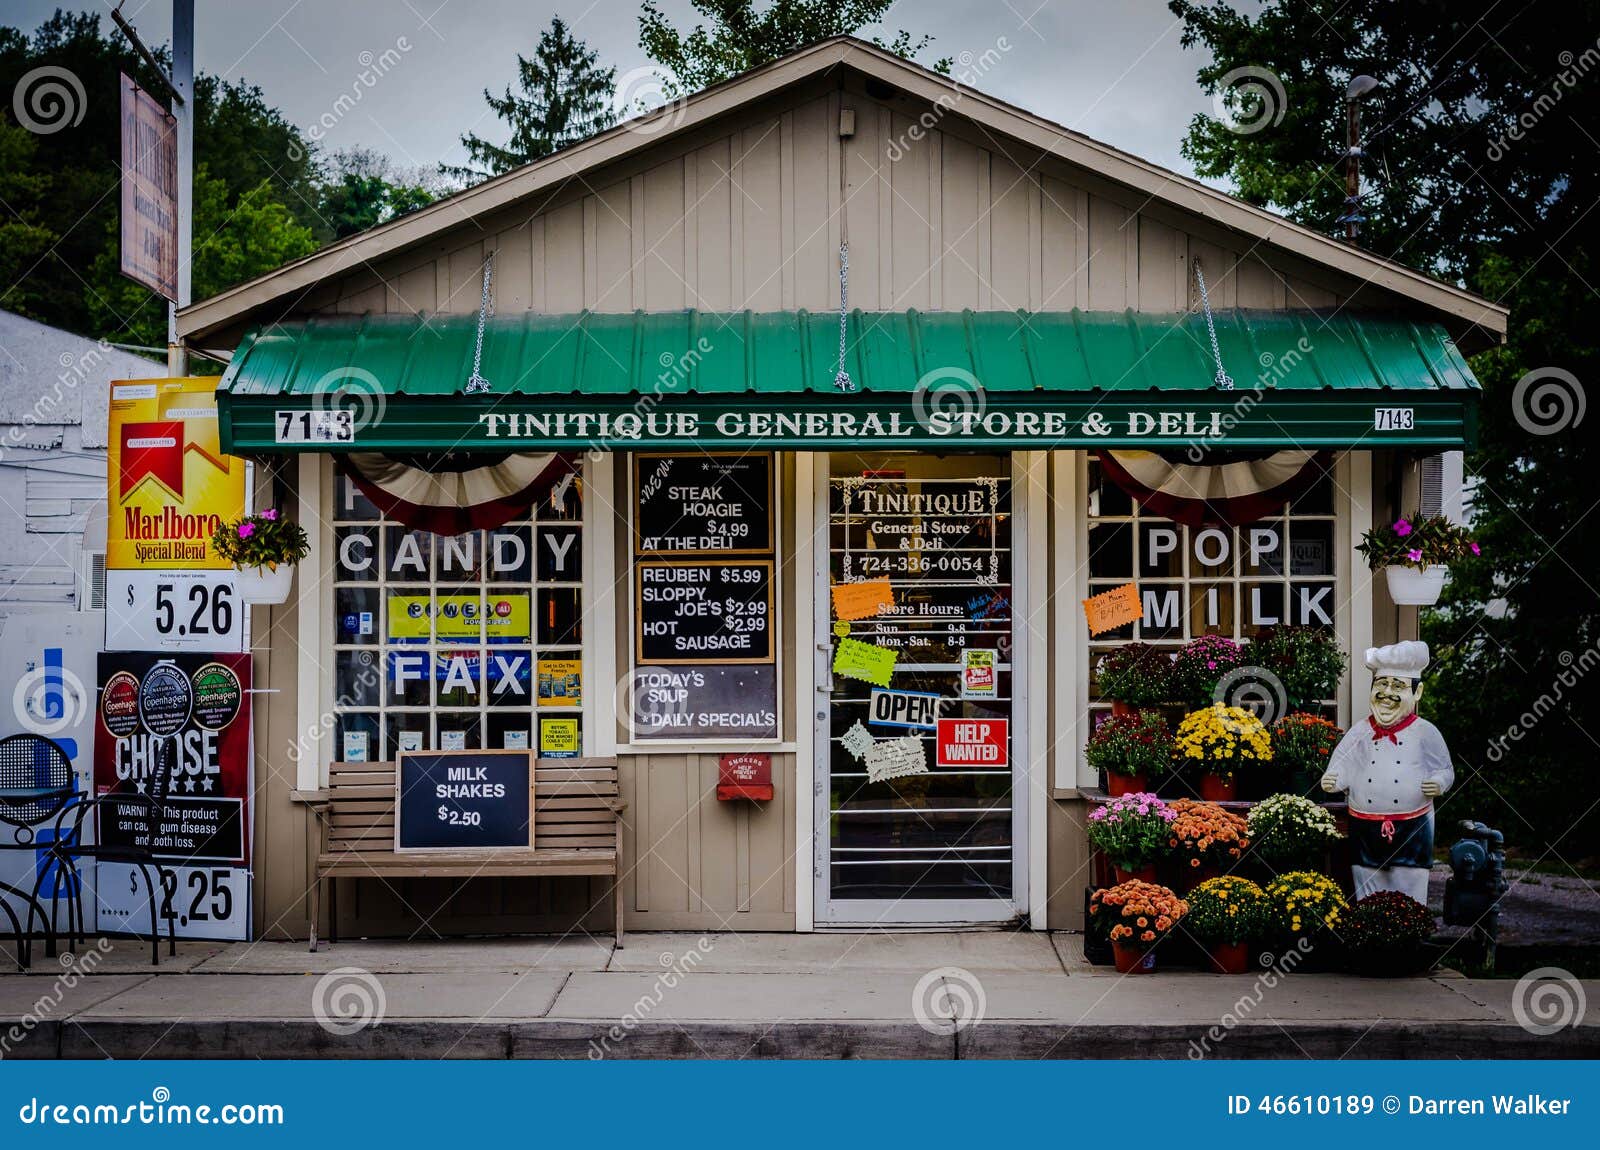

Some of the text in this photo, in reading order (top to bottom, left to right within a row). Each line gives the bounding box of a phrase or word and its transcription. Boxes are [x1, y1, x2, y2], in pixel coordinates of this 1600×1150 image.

[480, 411, 1223, 440] TINITIQUE GENERAL STORE & DELI
[1376, 409, 1413, 430] 7143
[668, 486, 723, 500] STEAK
[683, 502, 743, 517] HOAGIE
[858, 490, 985, 515] TINITIQUE
[124, 505, 220, 540] Marlboro
[707, 519, 749, 536] $4.99
[871, 521, 970, 534] General Store
[642, 537, 733, 550] AT THE DELI
[899, 537, 943, 550] & Deli
[1148, 528, 1279, 567] POP
[135, 542, 206, 563] Special Blend
[340, 533, 576, 572] CANDY
[858, 556, 984, 571] 724-336-0054
[643, 567, 761, 583] REUBEN $5.99
[643, 587, 706, 601] SLOPPY
[155, 584, 233, 636] 5.26
[674, 597, 767, 616] JOE'S $2.99
[878, 603, 964, 615] Store Hours:
[1142, 587, 1333, 628] MILK
[643, 615, 765, 636] HOT $2.99
[947, 623, 966, 634] 9-8
[675, 635, 751, 650] SAUSAGE
[875, 636, 966, 647] Mon.-Sat. 8-8
[395, 656, 525, 695] FAX
[638, 670, 705, 688] TODAY'S
[144, 695, 187, 711] Copenhagen
[648, 689, 689, 703] SOUP
[106, 699, 137, 713] Copenhage
[875, 693, 937, 724] OPEN
[698, 709, 776, 727] SPECIAL'S
[954, 723, 991, 744] HELP
[945, 744, 998, 761] WANTED
[728, 757, 763, 767] SMOKERS
[448, 767, 488, 781] MILK
[436, 784, 505, 798] SHAKES
[182, 808, 219, 821] product
[438, 804, 481, 826] $2.50
[119, 821, 217, 834] can cau gum disease
[135, 834, 196, 848] and ooth loss.
[160, 868, 233, 927] 2.25
